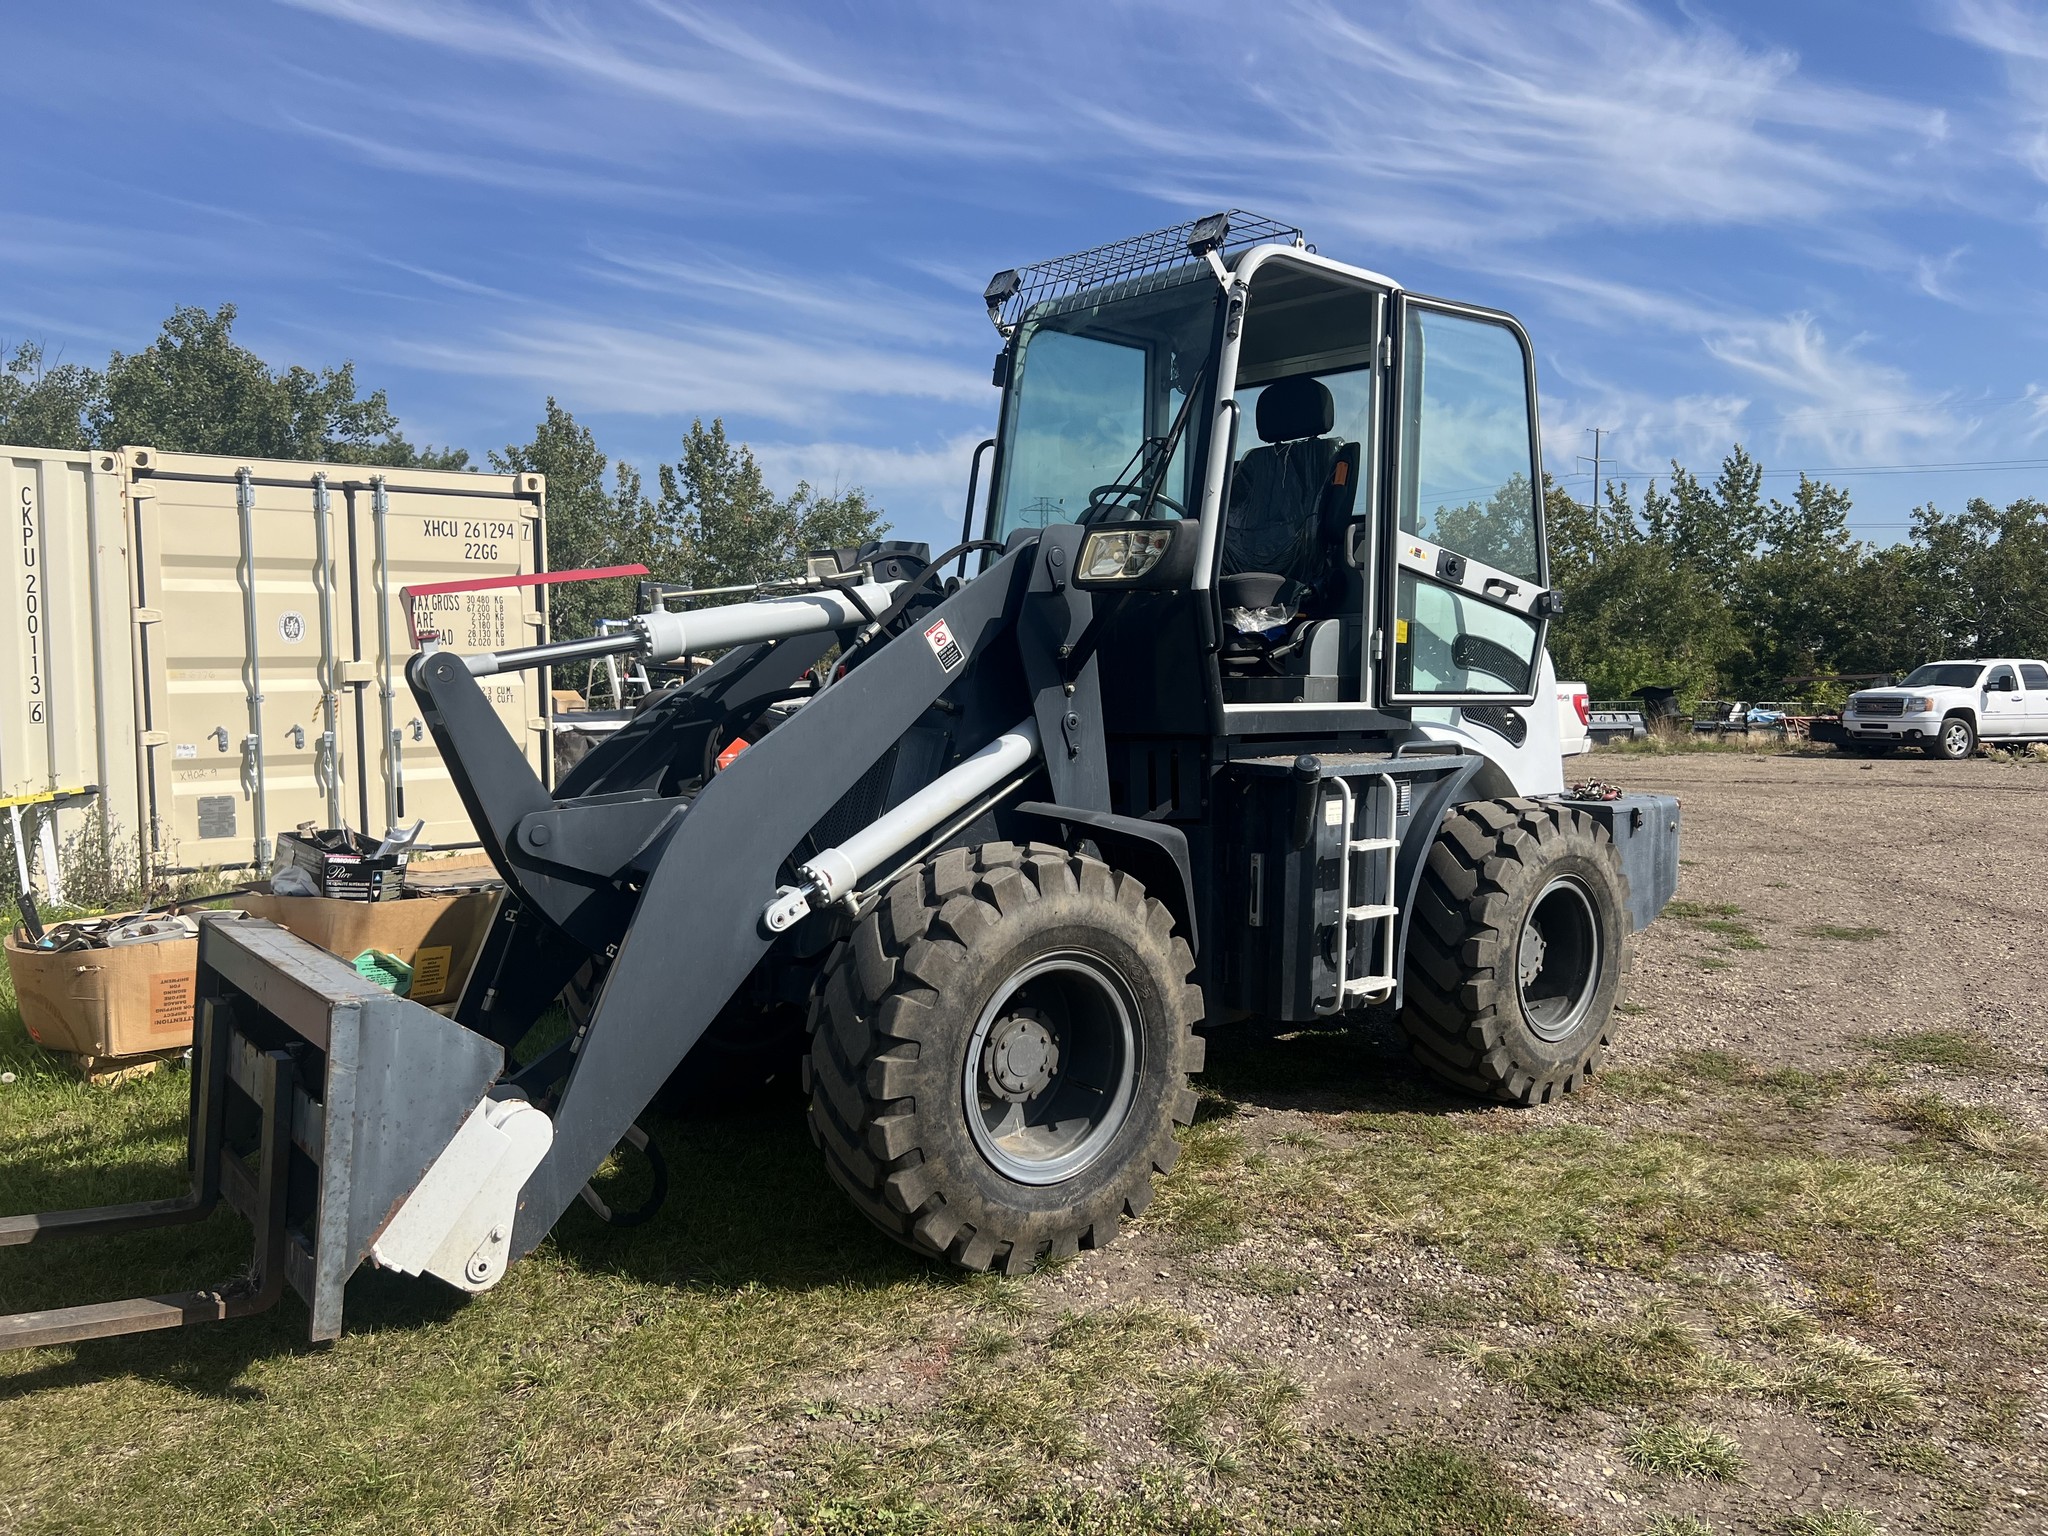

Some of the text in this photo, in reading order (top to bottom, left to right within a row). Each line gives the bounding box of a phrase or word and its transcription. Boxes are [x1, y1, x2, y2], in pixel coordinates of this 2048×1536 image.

[423, 519, 530, 540] XHCU 261294 7
[464, 543, 498, 560] 22GG
[21, 486, 42, 722] CKPU 200113 6
[432, 594, 460, 611] GROSS
[494, 595, 504, 604] KG
[494, 604, 504, 613] LB
[495, 612, 505, 621] KG
[495, 621, 505, 630] LB
[495, 629, 505, 638] KG
[495, 638, 505, 647] LB
[328, 857, 361, 865] SIMONIZ
[326, 864, 353, 879] Pure
